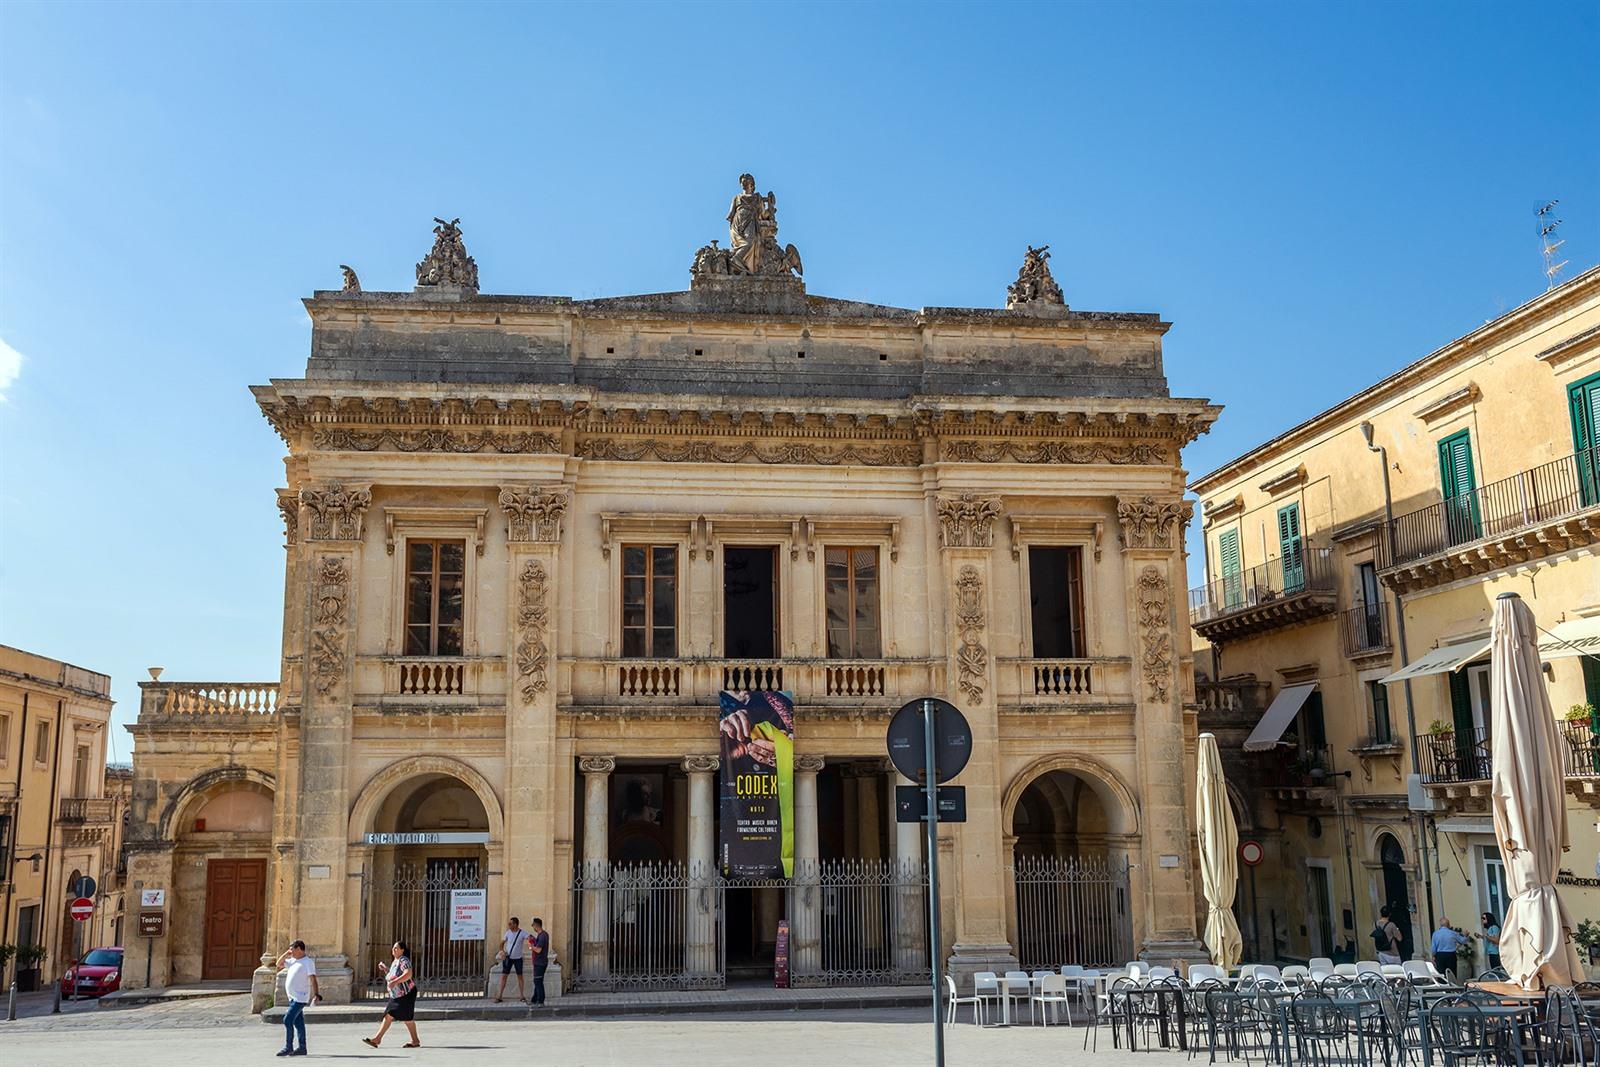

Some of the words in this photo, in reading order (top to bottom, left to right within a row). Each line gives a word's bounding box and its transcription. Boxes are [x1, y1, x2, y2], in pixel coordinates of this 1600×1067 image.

[736, 774, 778, 795] CODEX
[368, 832, 440, 844] ENCANTADORA
[141, 916, 162, 924] Teatro
